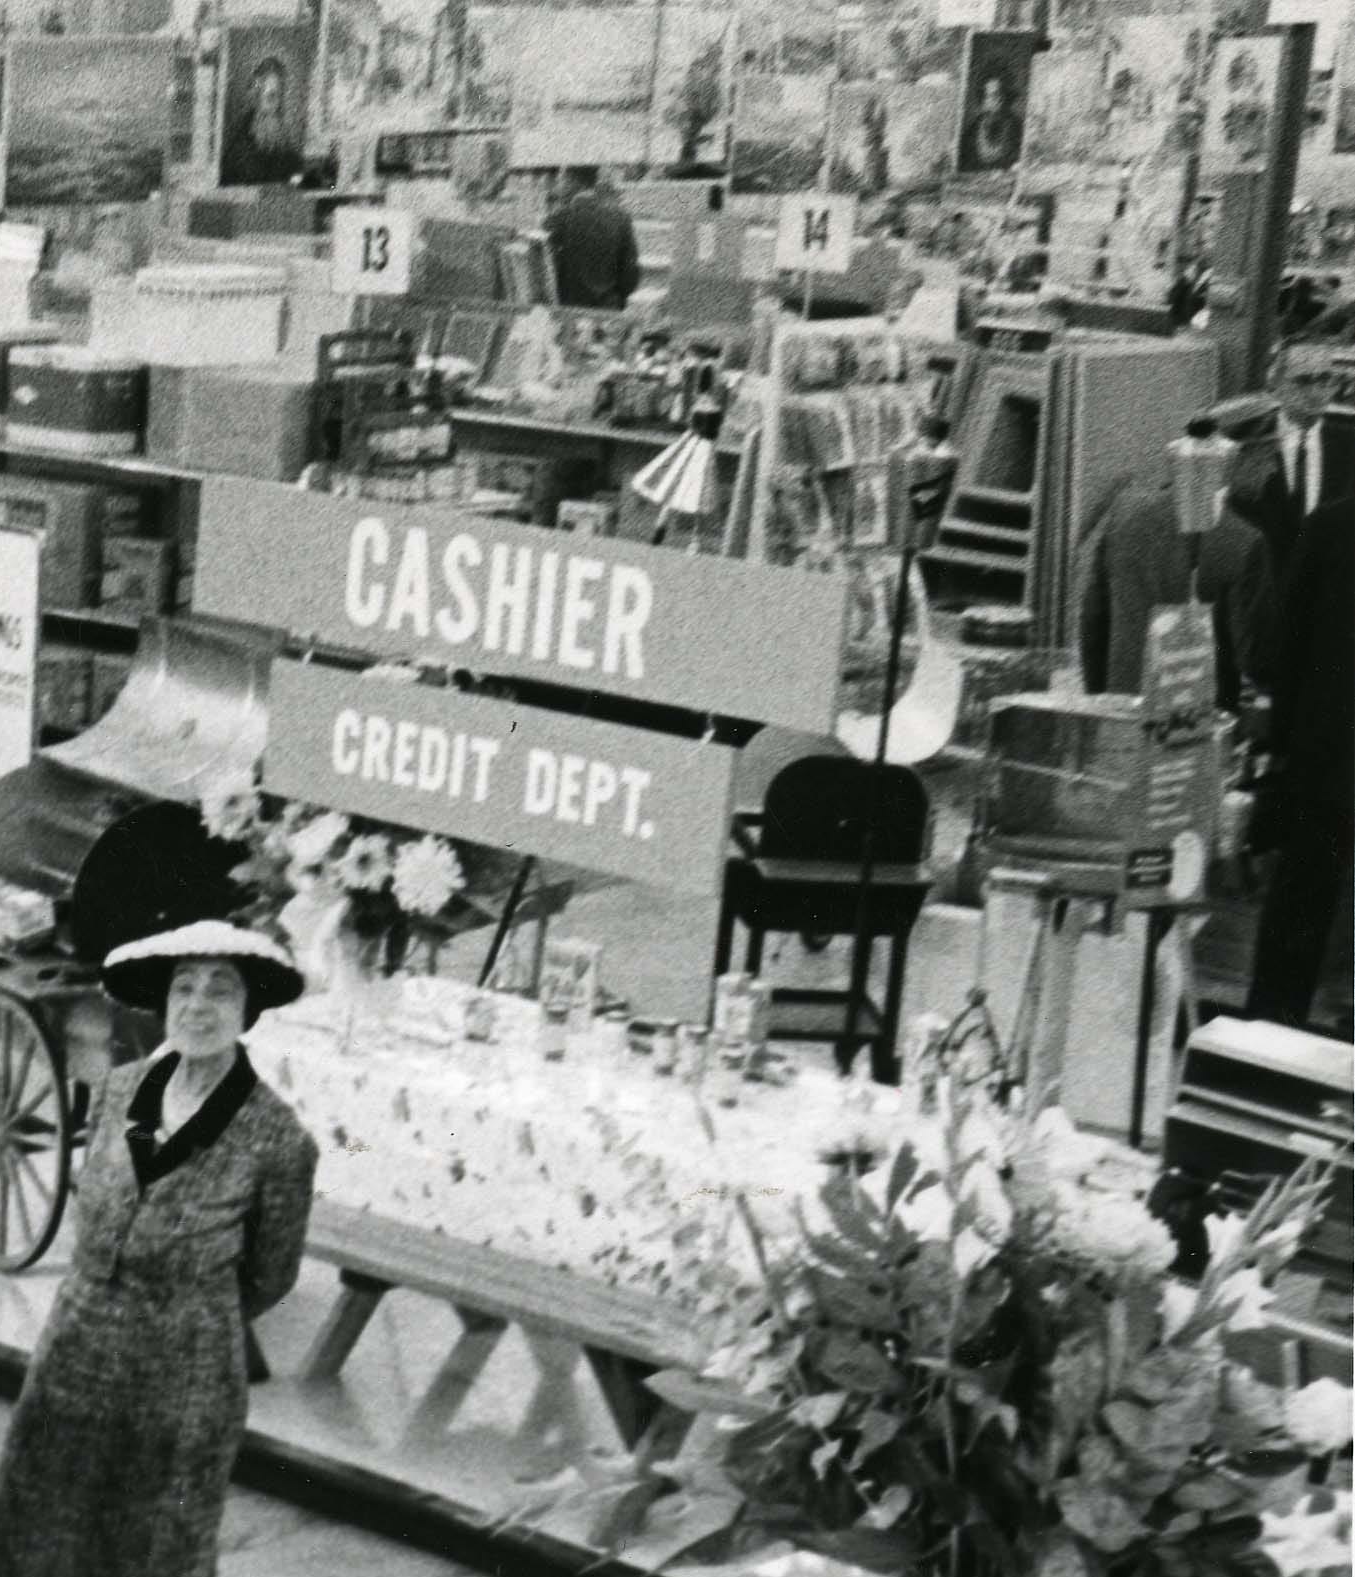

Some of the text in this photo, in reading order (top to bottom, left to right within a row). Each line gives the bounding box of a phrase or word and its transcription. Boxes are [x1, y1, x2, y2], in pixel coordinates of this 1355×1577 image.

[362, 226, 389, 272] 13
[804, 209, 830, 251] 14
[344, 515, 655, 680] CASHIER
[332, 708, 655, 840] CREDIT DEPT.
